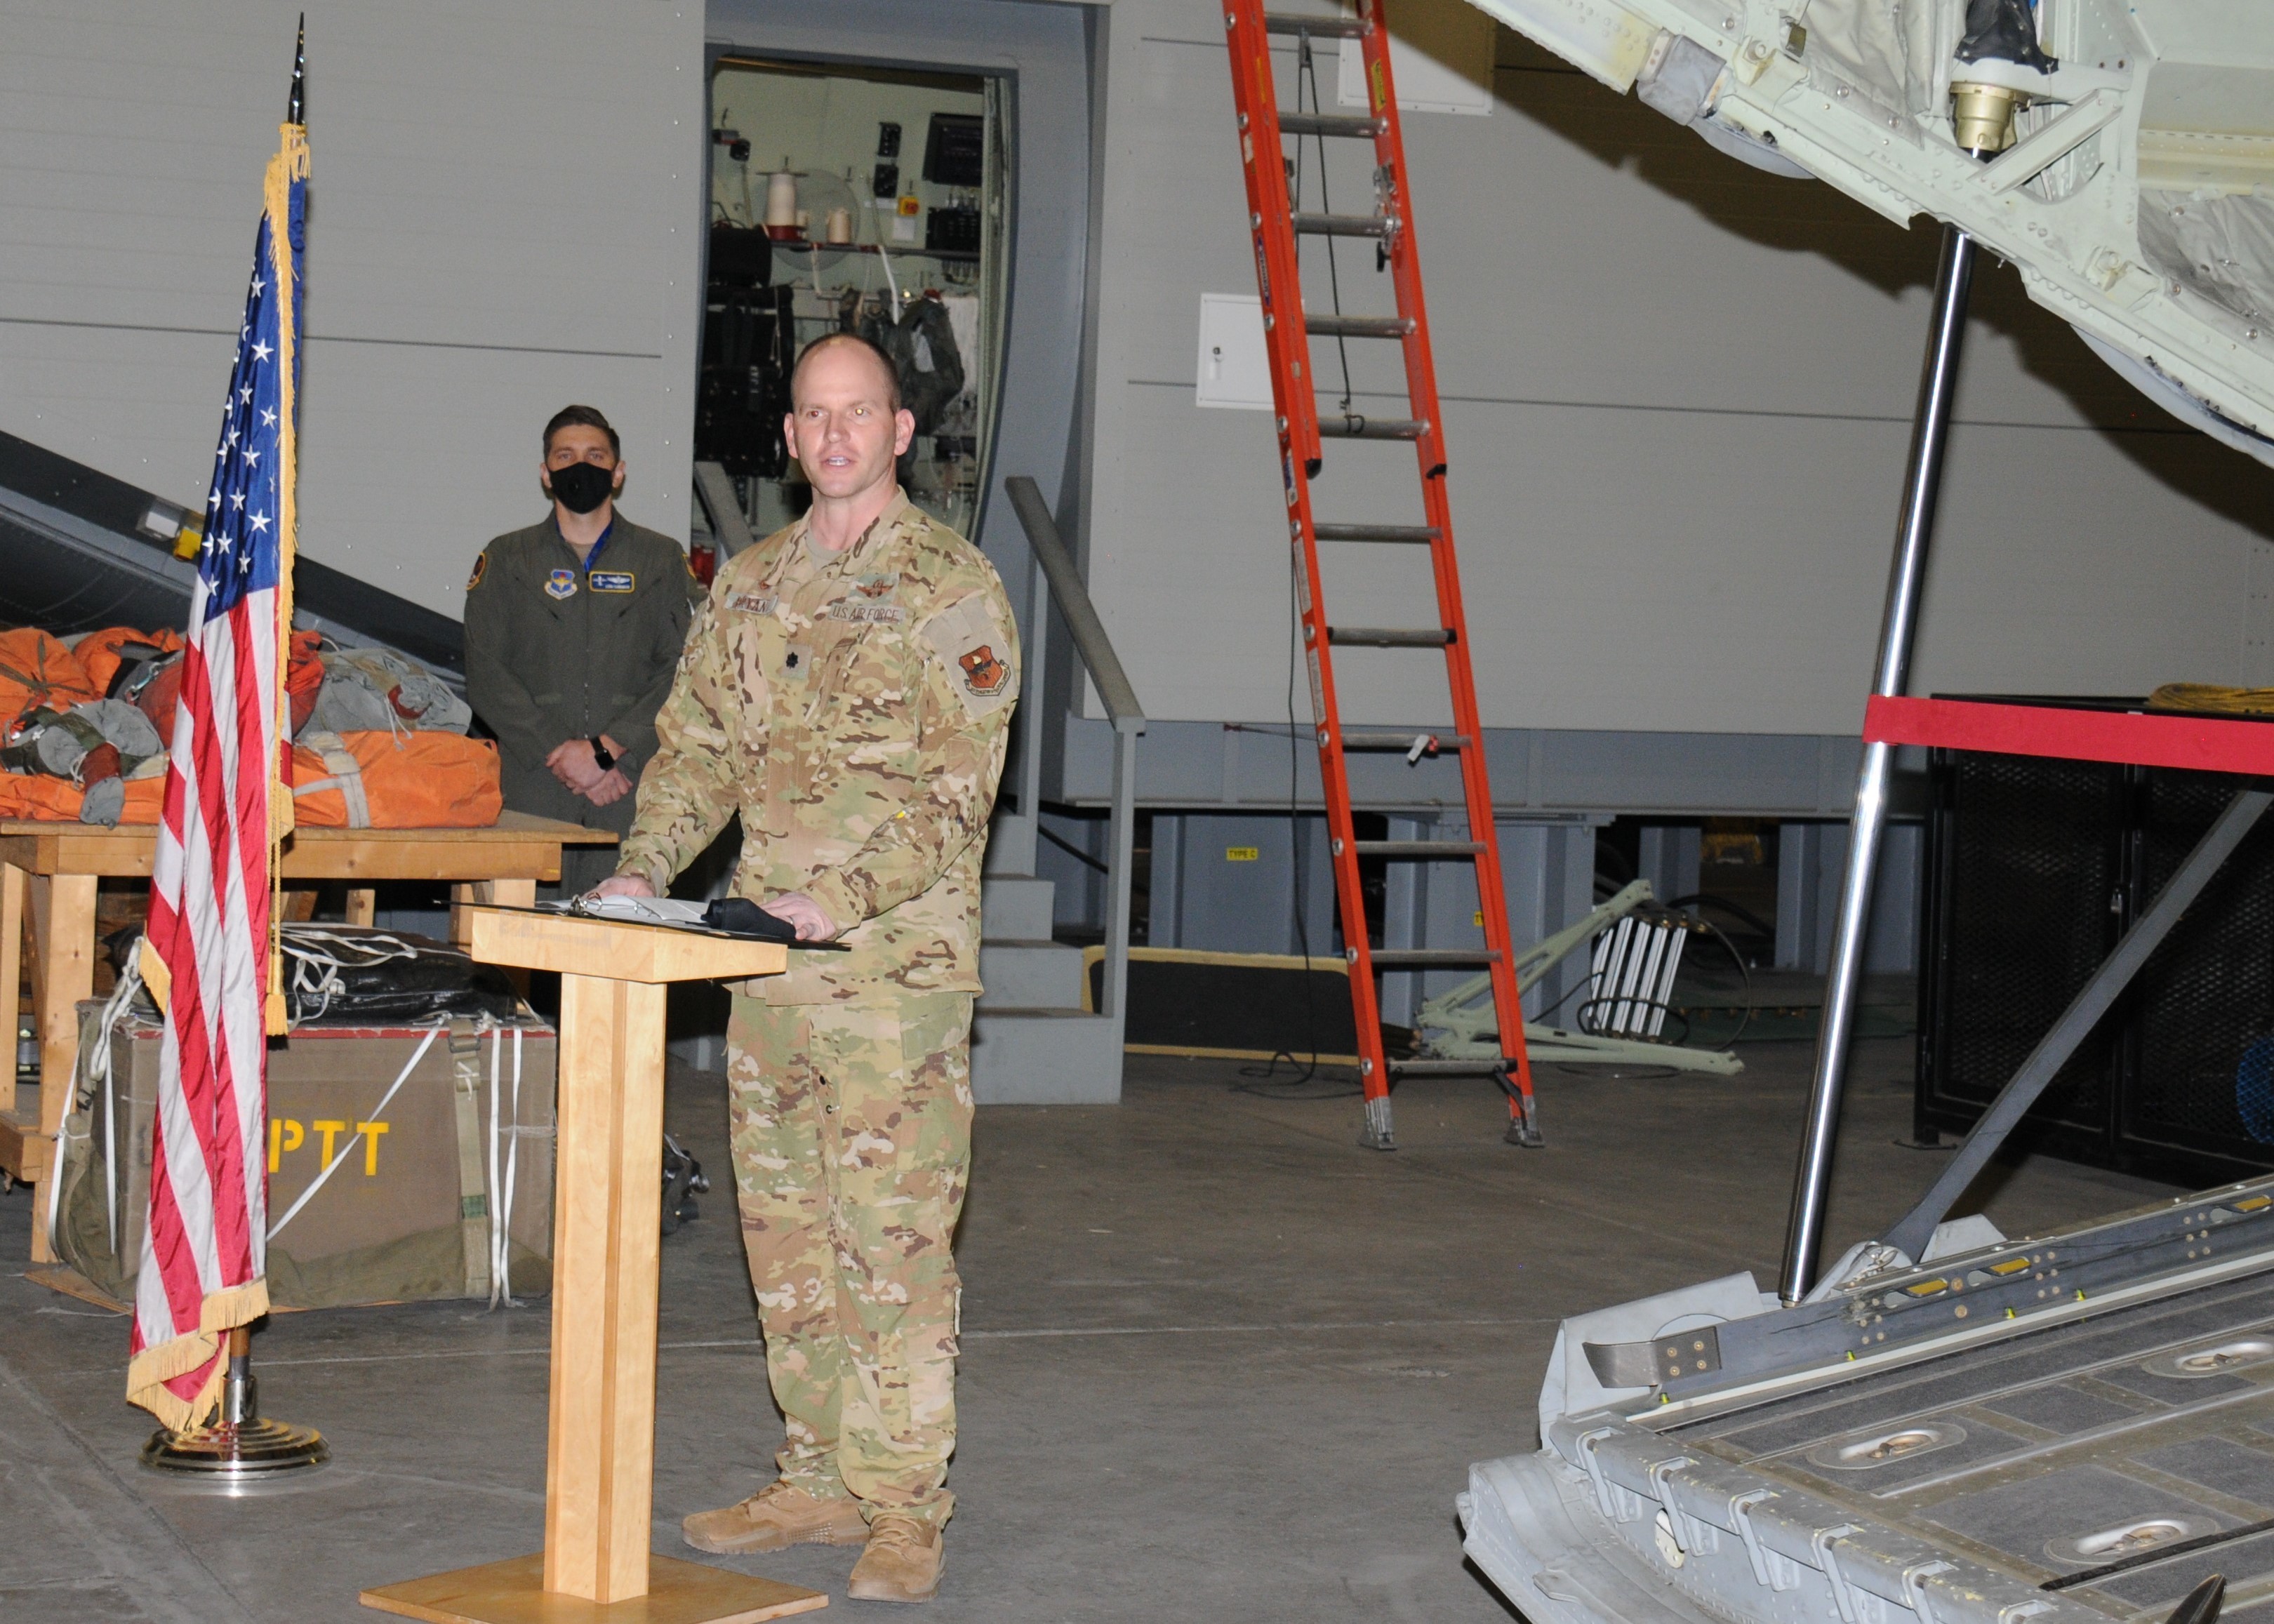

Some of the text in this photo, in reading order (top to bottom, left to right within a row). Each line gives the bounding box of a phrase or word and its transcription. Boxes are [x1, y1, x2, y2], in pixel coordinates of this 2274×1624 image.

[849, 607, 865, 620] AIR
[866, 608, 899, 621] FORCE
[1229, 850, 1248, 858] TYPE
[268, 1119, 389, 1176] PTT
